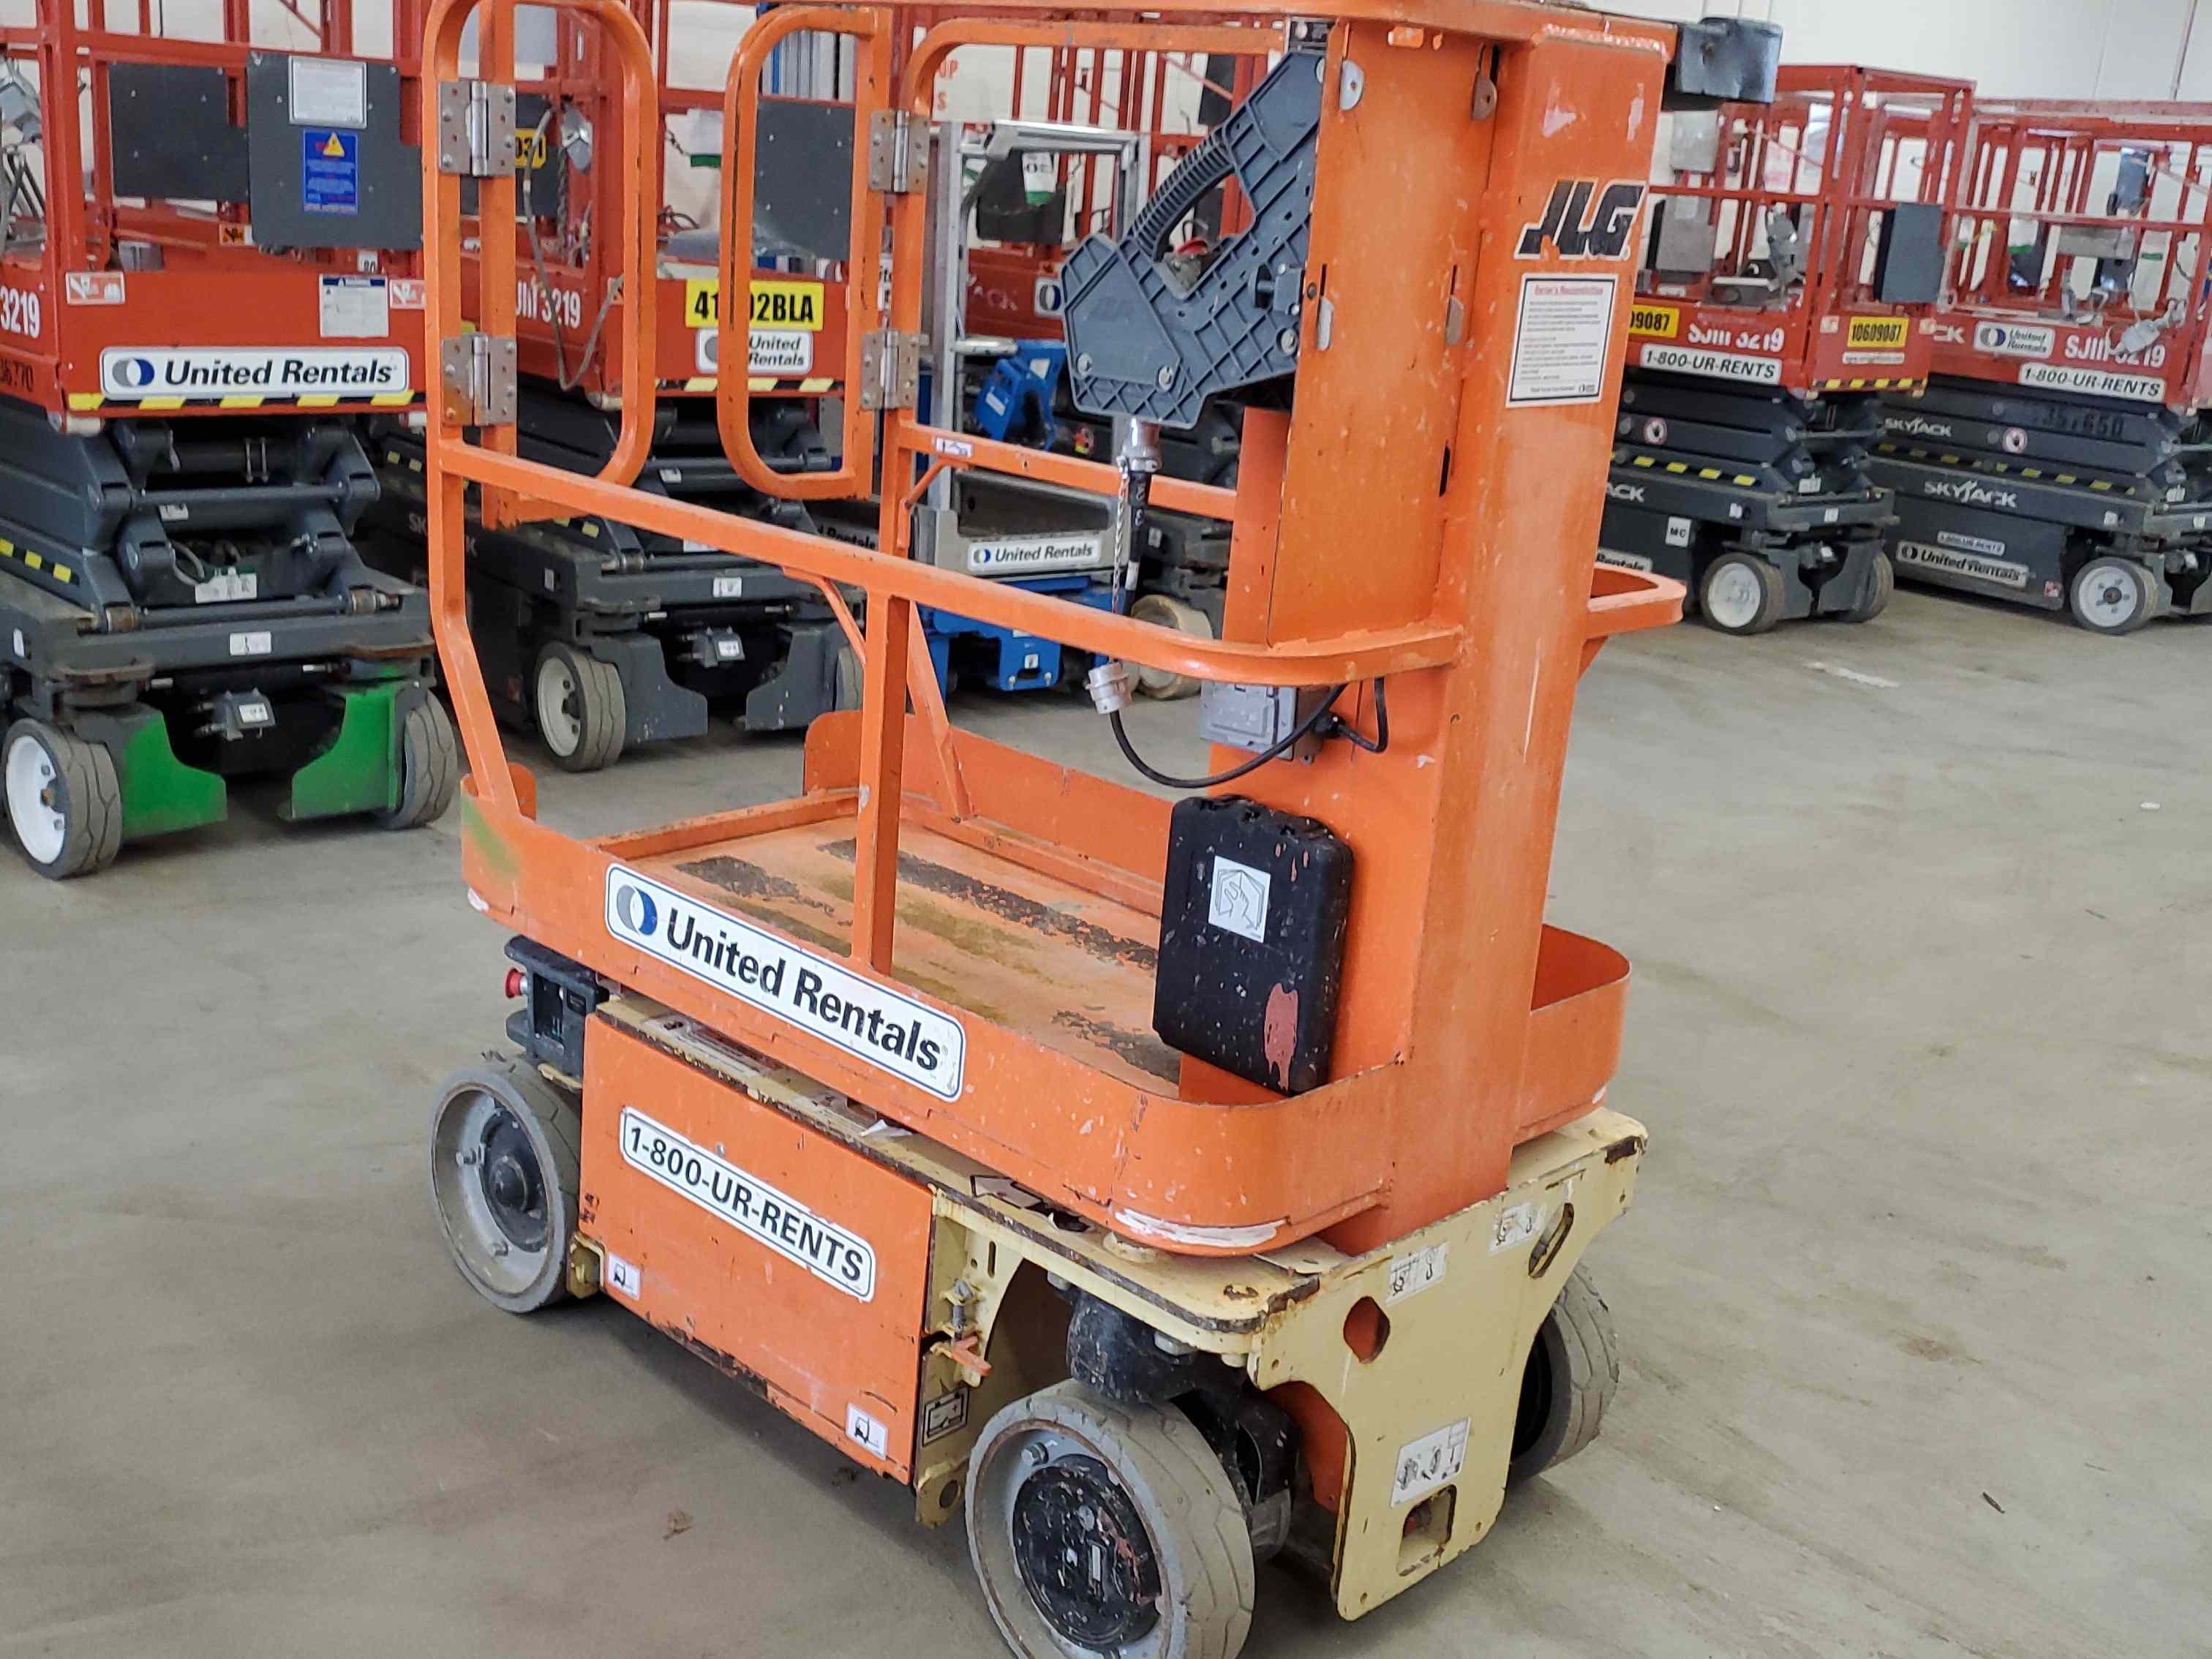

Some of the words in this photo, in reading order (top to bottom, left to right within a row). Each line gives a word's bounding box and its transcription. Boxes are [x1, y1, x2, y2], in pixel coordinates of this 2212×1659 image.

[1514, 178, 1646, 260] JLG
[0, 285, 40, 339] 3219
[749, 335, 802, 351] United
[165, 359, 271, 385] United
[282, 358, 392, 385] Rentals
[749, 353, 805, 366] Rentals
[1647, 350, 1776, 379] 1-800-UR-RENTS
[2024, 368, 2161, 396] 1-800-UR-RENTS
[1885, 416, 1952, 437] SKYJACK
[1924, 481, 2019, 508] SKYJACK
[996, 546, 1042, 563] United
[1045, 543, 1093, 560] Rentals
[1921, 549, 1966, 569] United
[667, 908, 786, 998] United
[794, 967, 941, 1071] Rentals
[631, 1126, 864, 1282] 1-800-UR-RENTS
